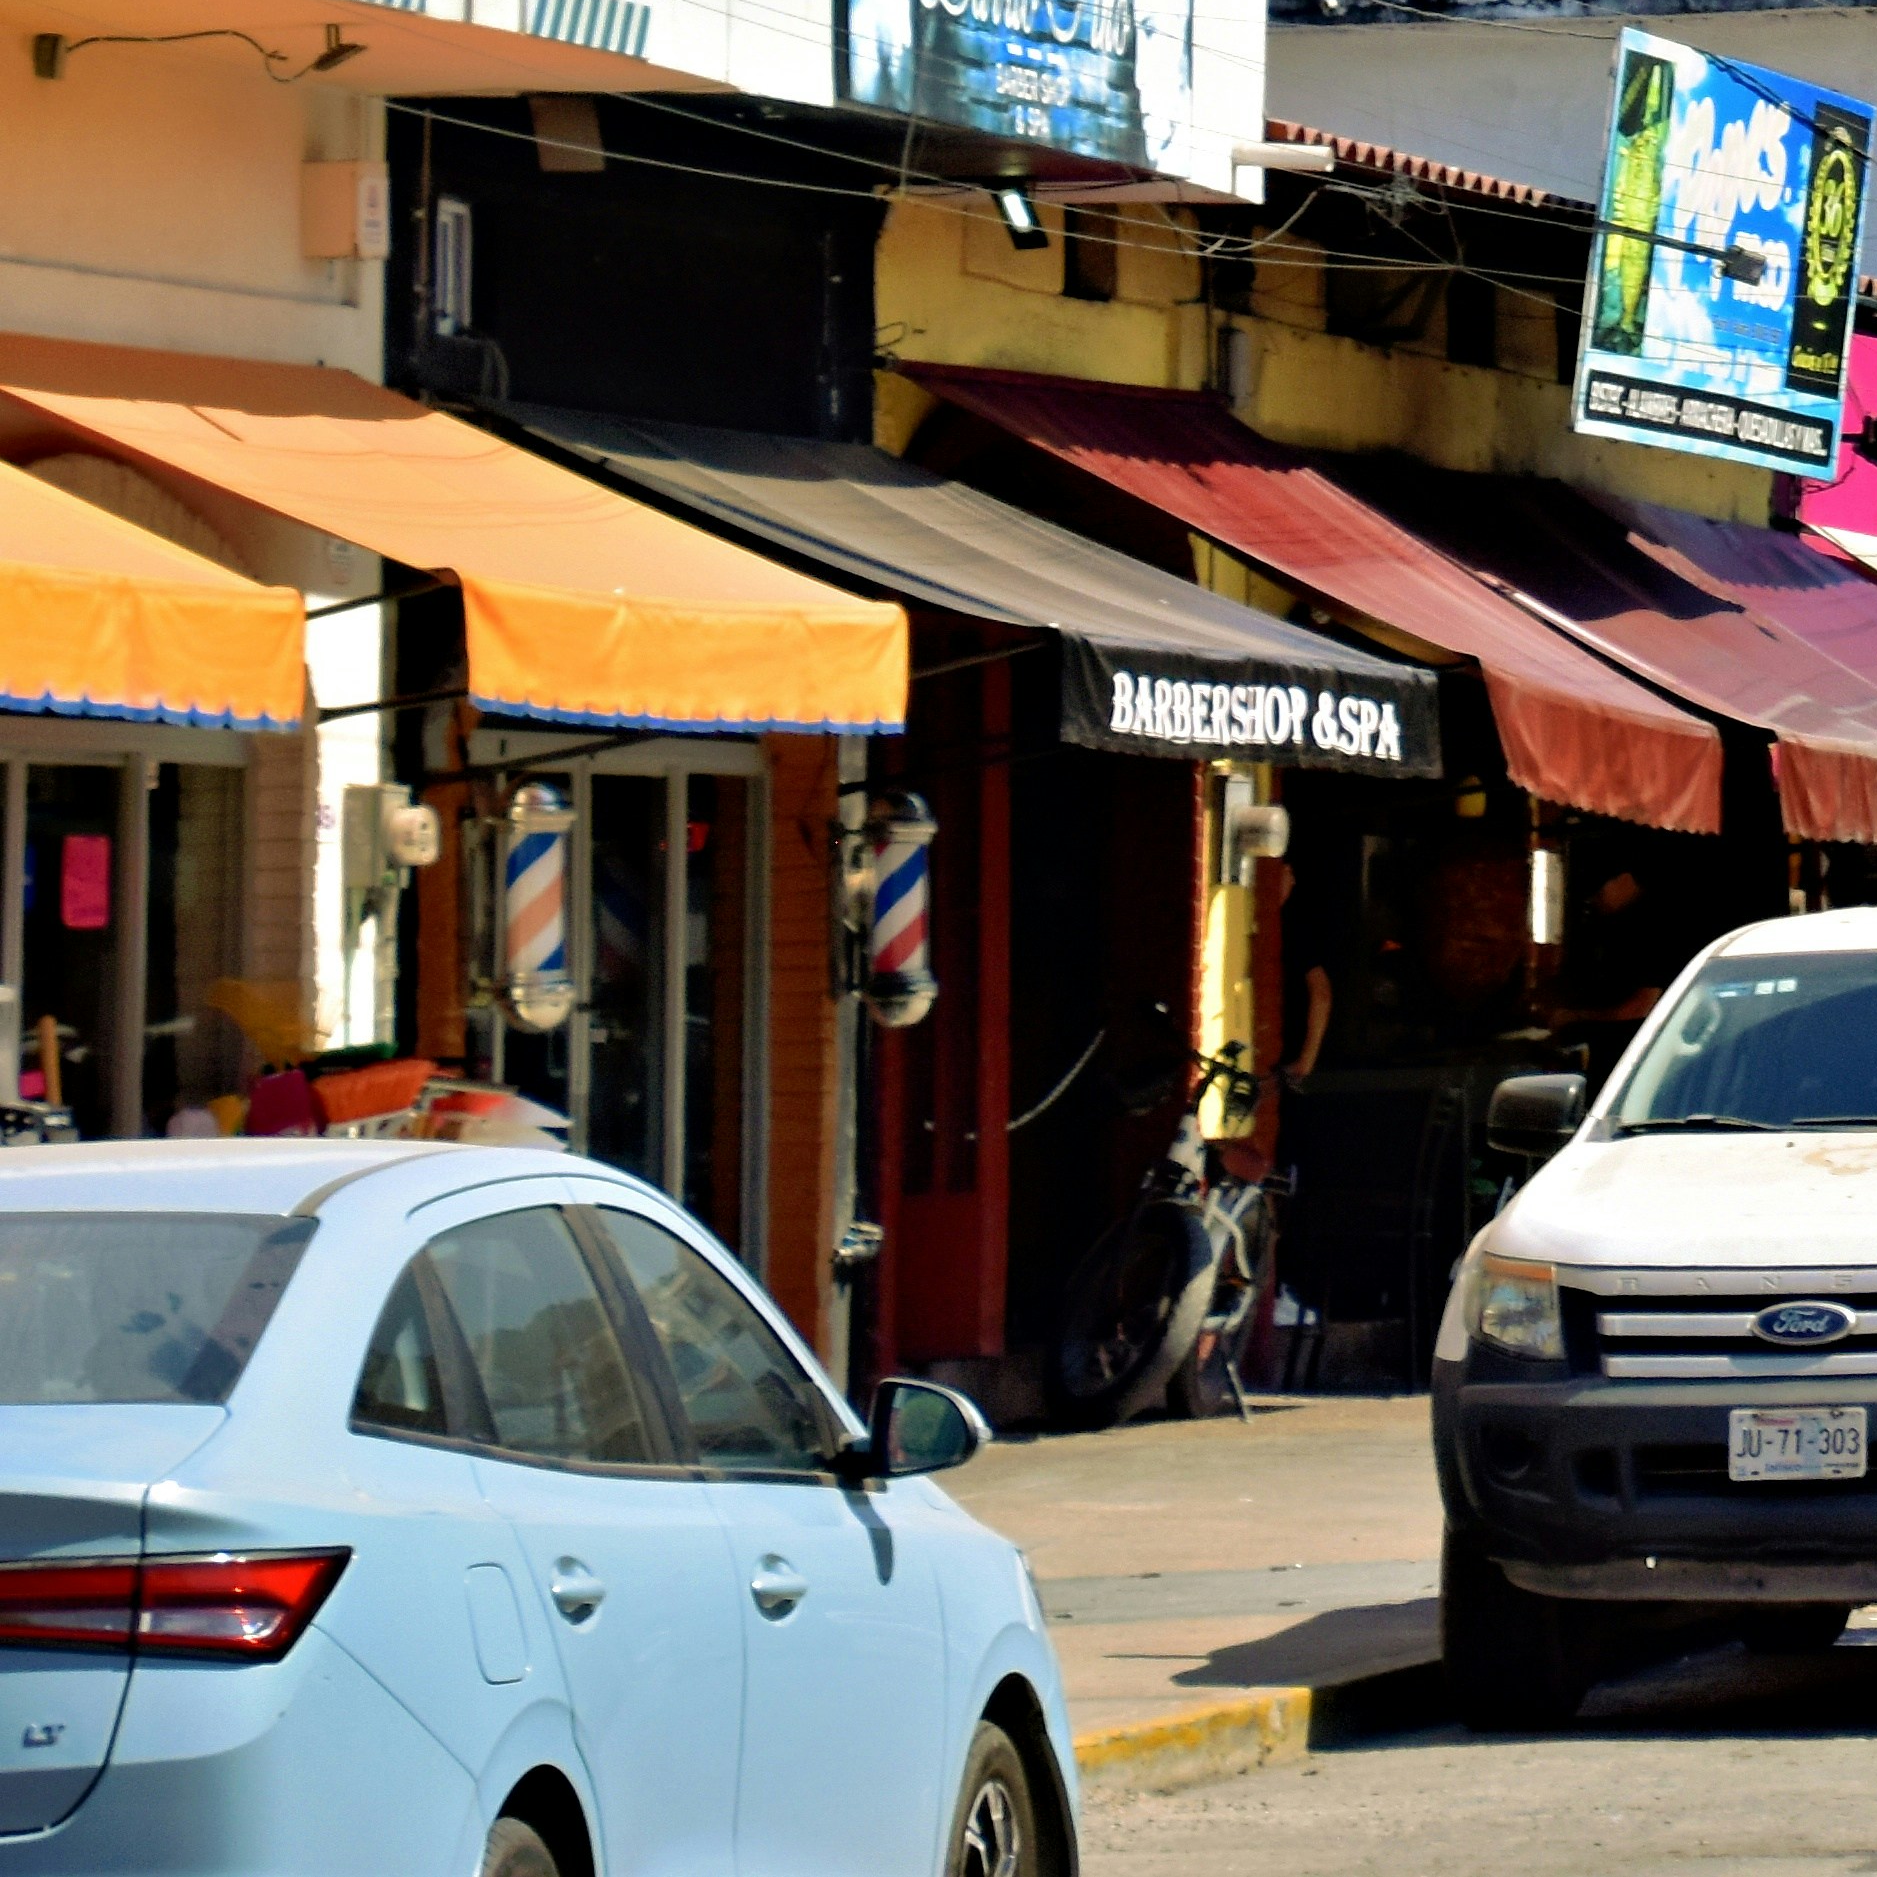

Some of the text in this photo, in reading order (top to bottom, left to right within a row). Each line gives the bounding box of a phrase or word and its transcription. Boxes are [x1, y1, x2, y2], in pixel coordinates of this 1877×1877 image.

[1110, 671, 1308, 745] BARBERSHOP
[1773, 1308, 1828, 1335] Ford
[1735, 1427, 1861, 1459] JU-71-303
